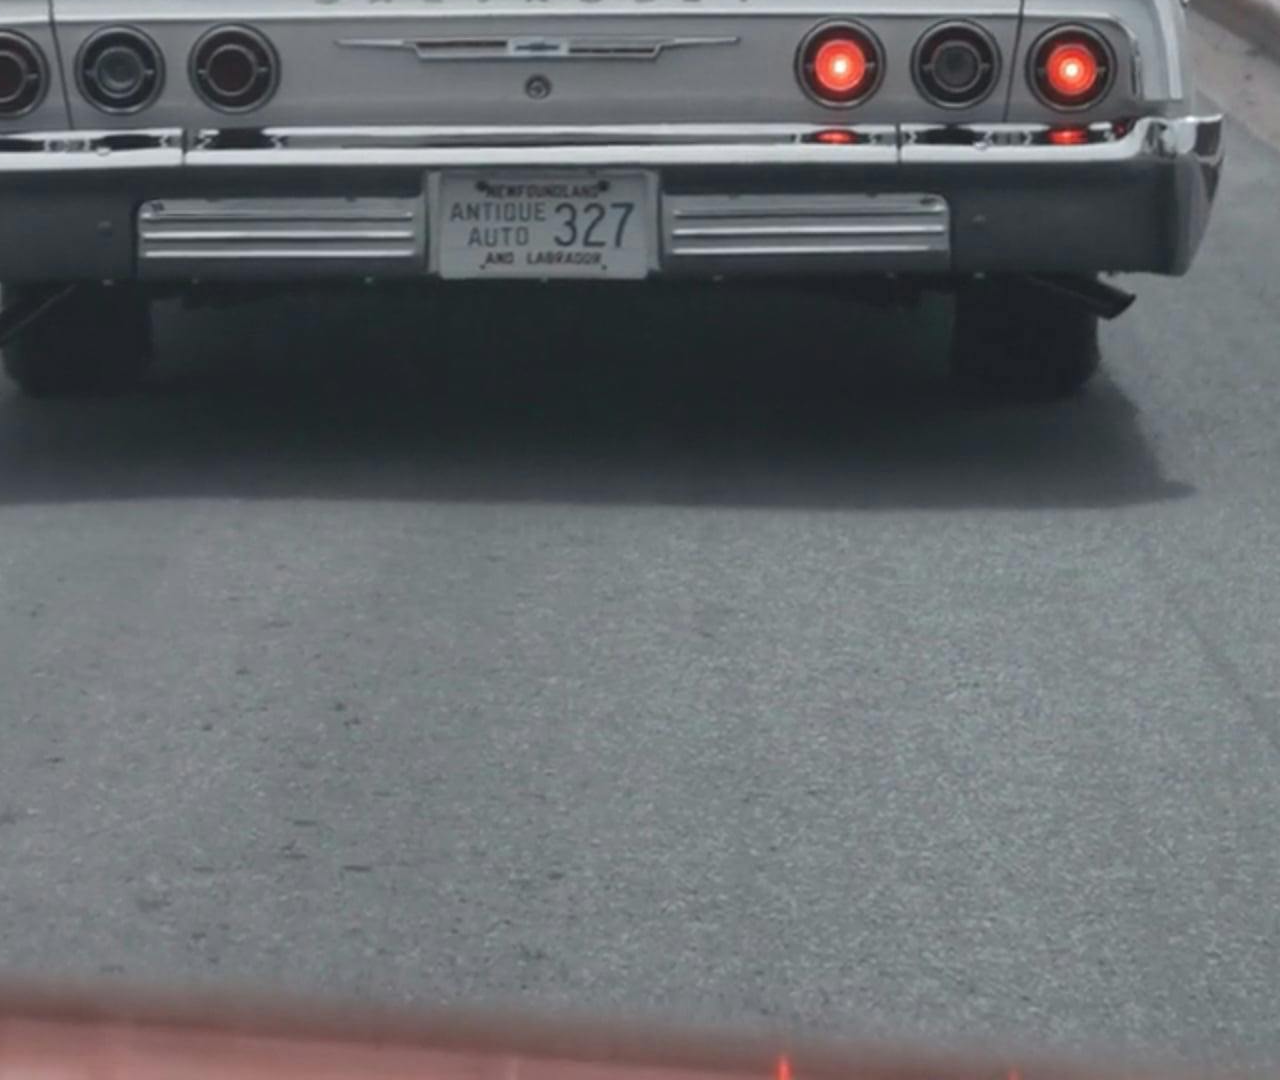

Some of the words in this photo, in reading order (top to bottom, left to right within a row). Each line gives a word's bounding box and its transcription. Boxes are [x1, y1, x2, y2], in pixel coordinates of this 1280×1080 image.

[484, 183, 600, 199] NEWFOUNDLAND
[450, 201, 547, 222] ANTIQUE
[553, 201, 636, 249] 327
[467, 226, 529, 248] AUTO
[484, 251, 515, 266] AND
[526, 251, 603, 266] LABRADOR
